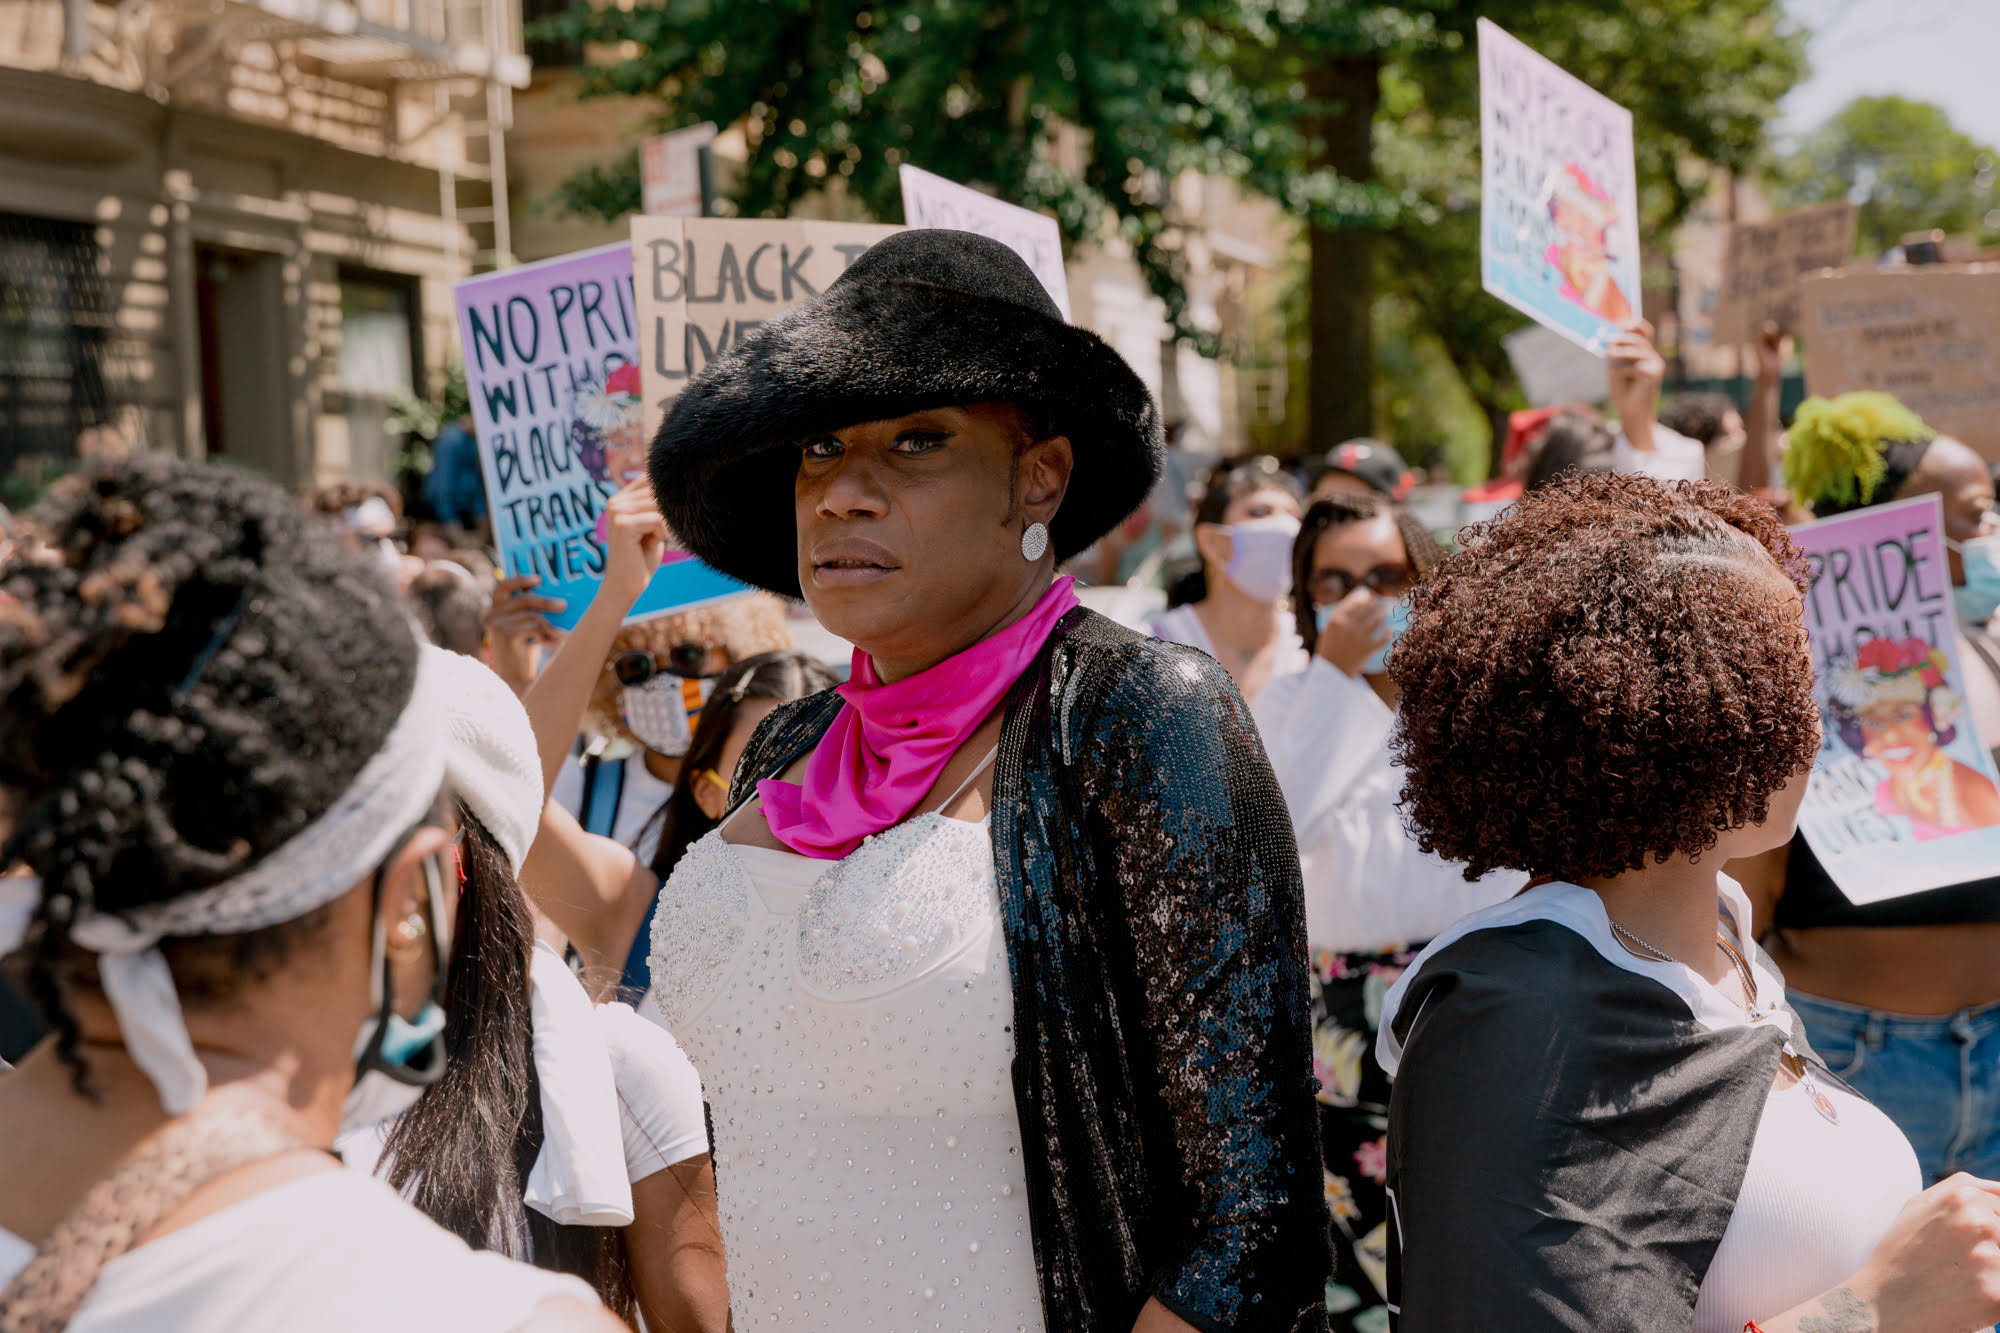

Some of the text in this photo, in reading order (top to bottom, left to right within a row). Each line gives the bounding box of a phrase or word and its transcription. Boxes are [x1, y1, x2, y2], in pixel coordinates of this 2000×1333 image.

[645, 238, 820, 304] BLACK
[468, 274, 636, 373] NO PRI
[1806, 529, 1943, 627] PRIDE
